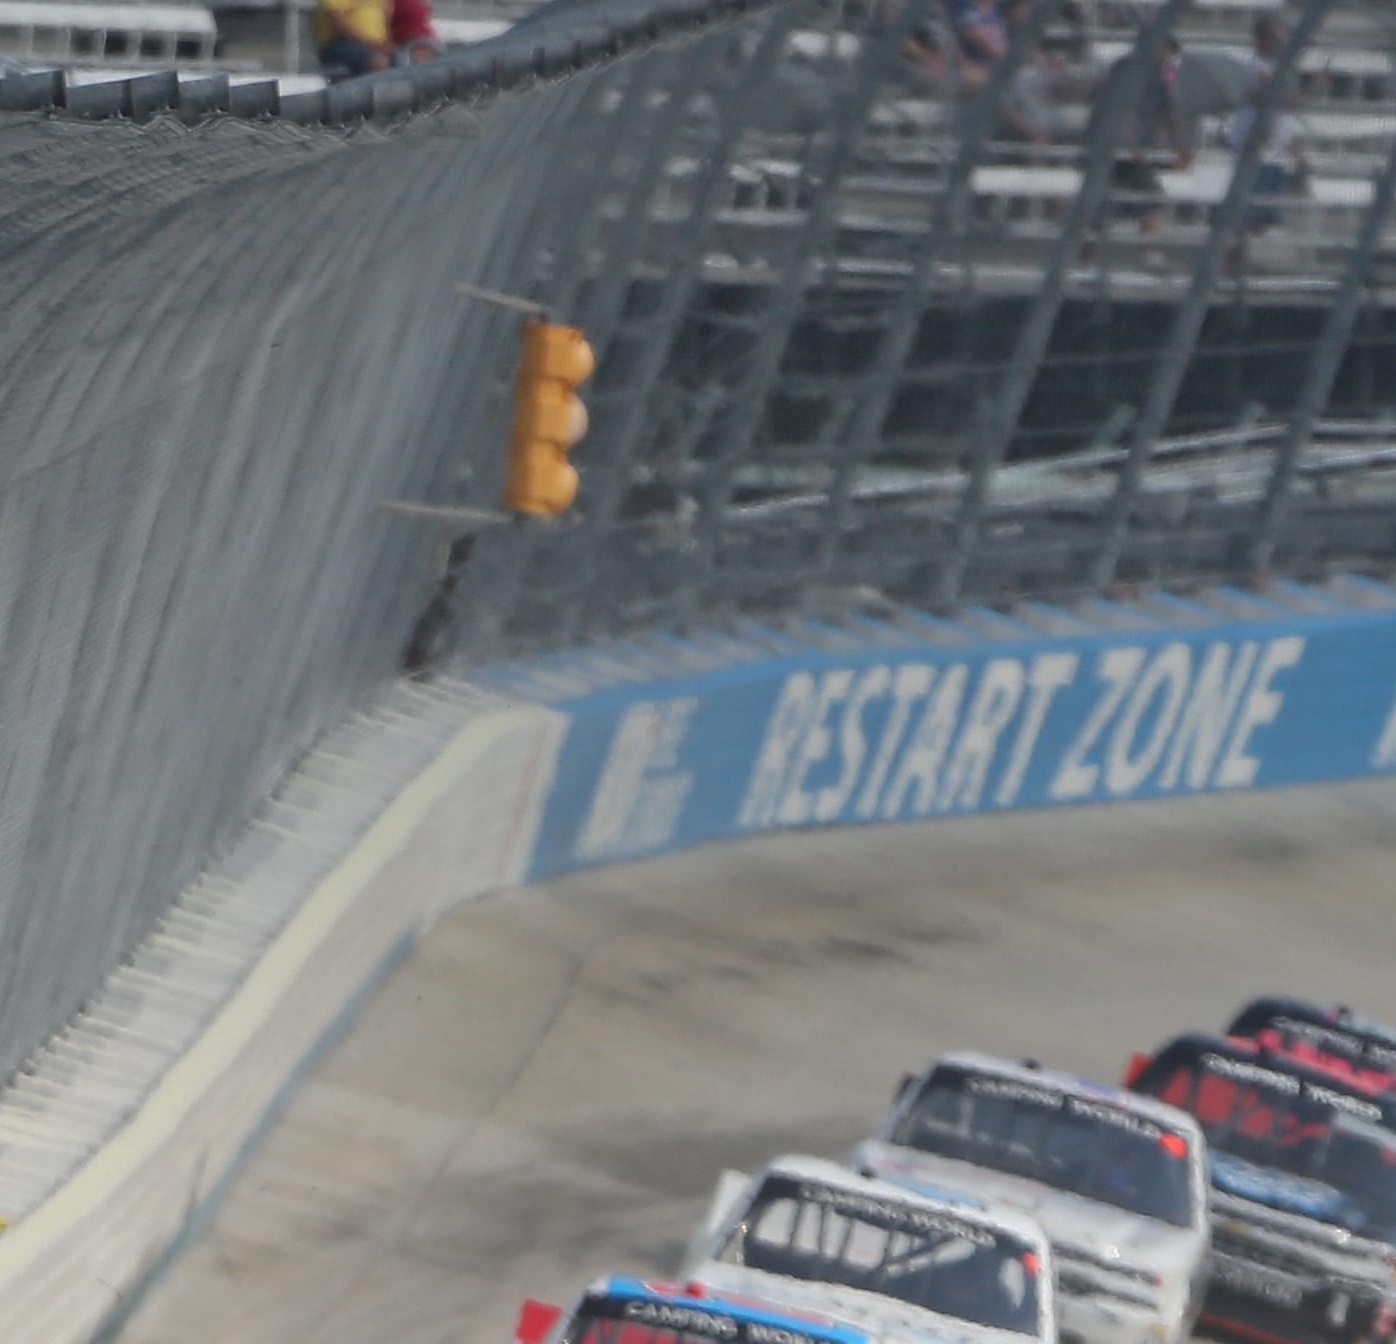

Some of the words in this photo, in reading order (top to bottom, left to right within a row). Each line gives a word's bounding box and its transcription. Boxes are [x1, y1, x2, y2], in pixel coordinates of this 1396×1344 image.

[738, 652, 1079, 827] RESTART
[1049, 636, 1304, 799] ZONE
[625, 1300, 738, 1340] CAMPING
